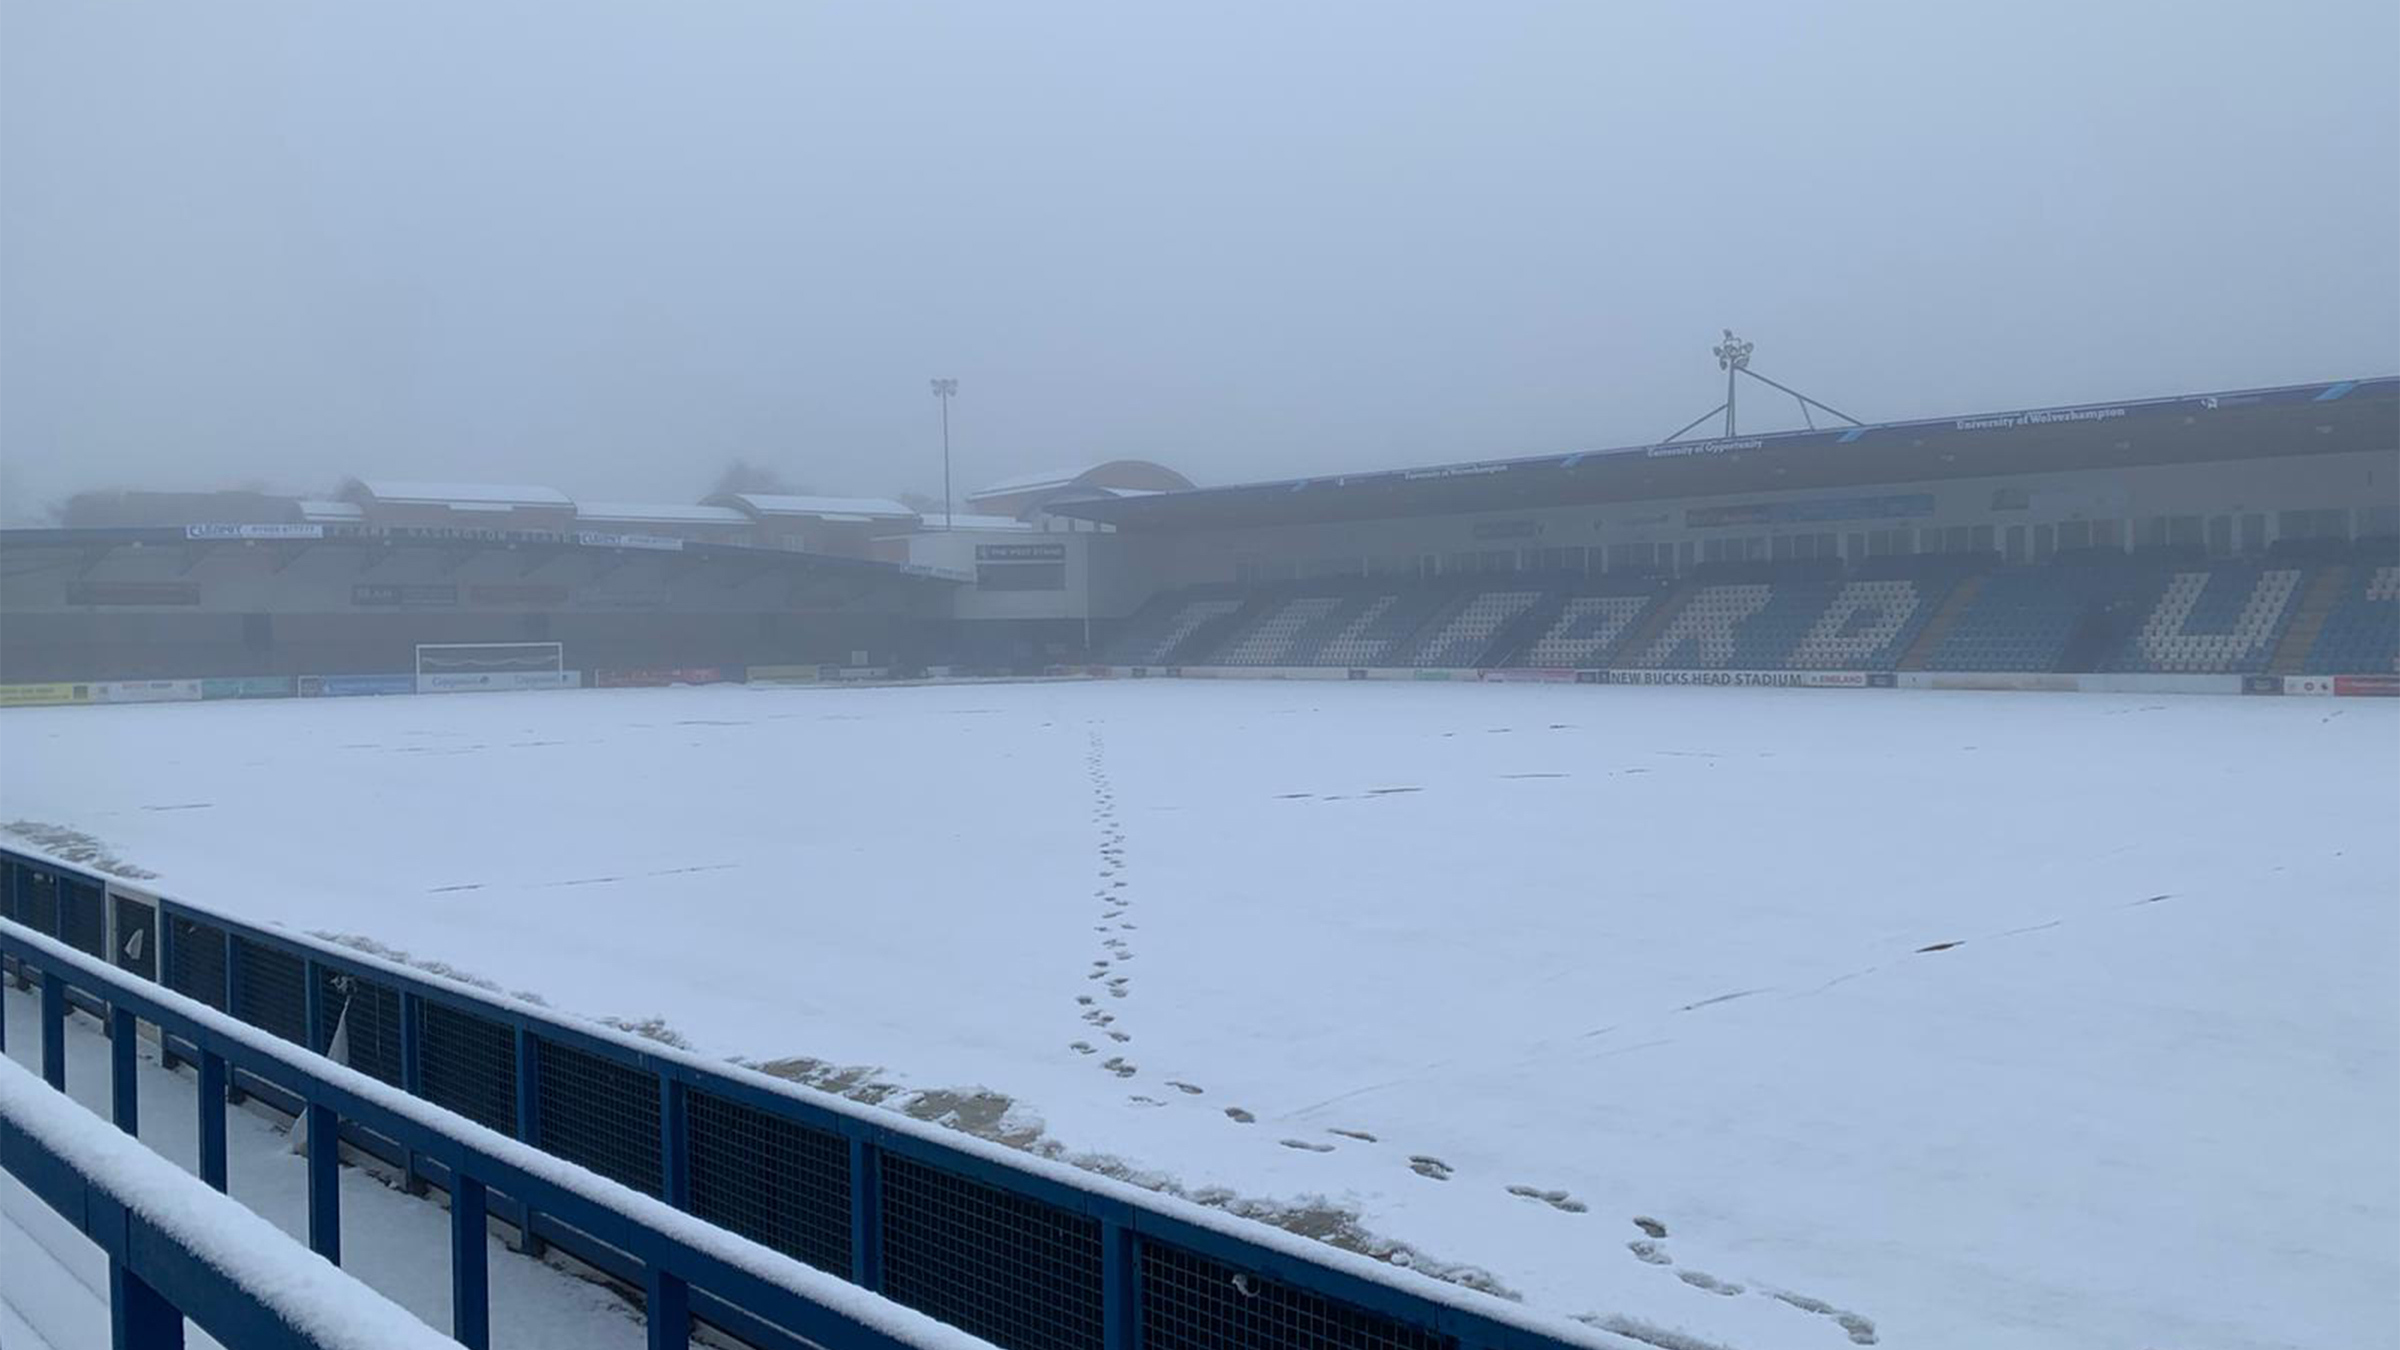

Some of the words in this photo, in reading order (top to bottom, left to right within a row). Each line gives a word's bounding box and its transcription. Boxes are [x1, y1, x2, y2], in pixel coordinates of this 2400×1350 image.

[1957, 418, 2013, 430] University
[2029, 408, 2125, 424] Wolverhampton
[1611, 672, 1641, 685] NEW
[1645, 672, 1688, 685] BUCKS
[1691, 673, 1730, 686] HEAD
[1735, 673, 1801, 687] STADIUM
